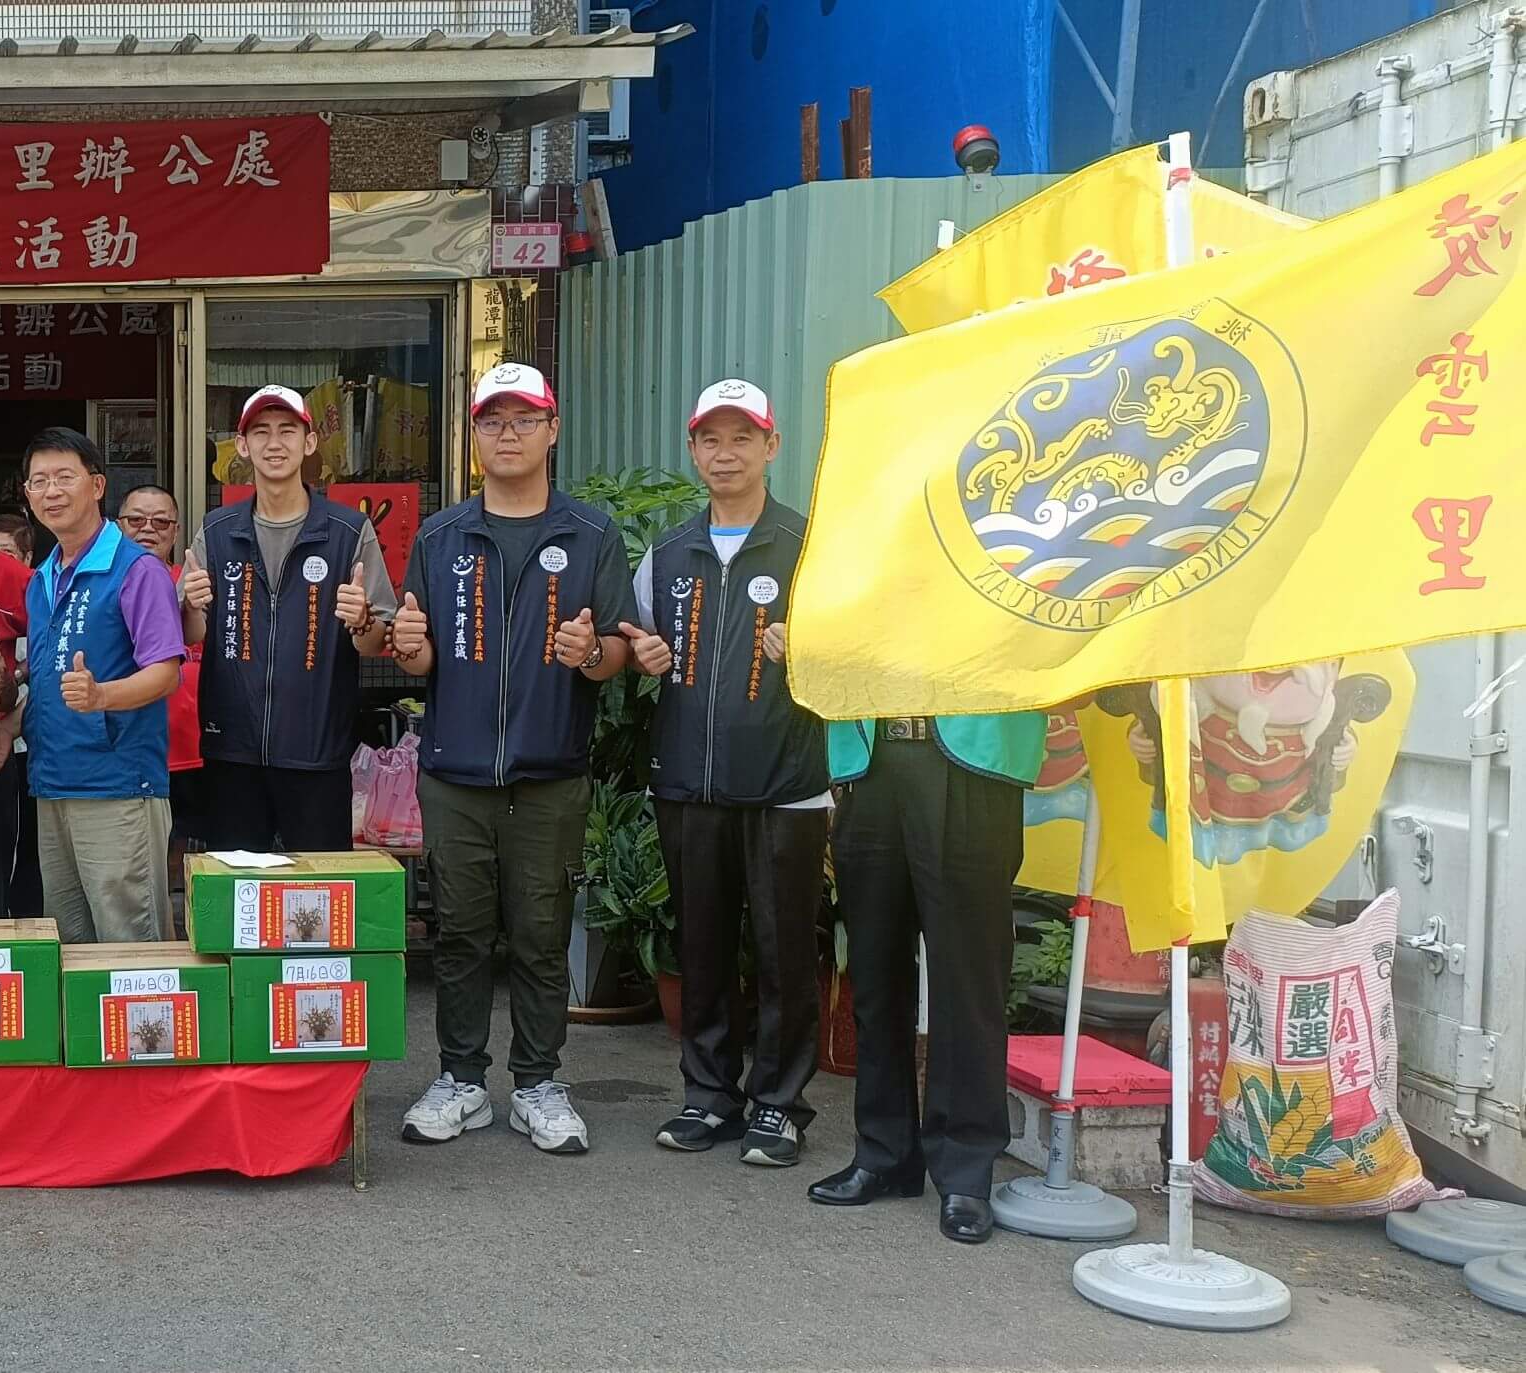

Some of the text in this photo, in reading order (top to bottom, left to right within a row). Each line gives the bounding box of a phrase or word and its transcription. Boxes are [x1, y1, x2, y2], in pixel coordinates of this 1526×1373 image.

[513, 243, 547, 264] 42
[457, 579, 467, 606] 主任
[76, 589, 90, 634] 凌雲里
[1287, 982, 1331, 1059] 嚴選
